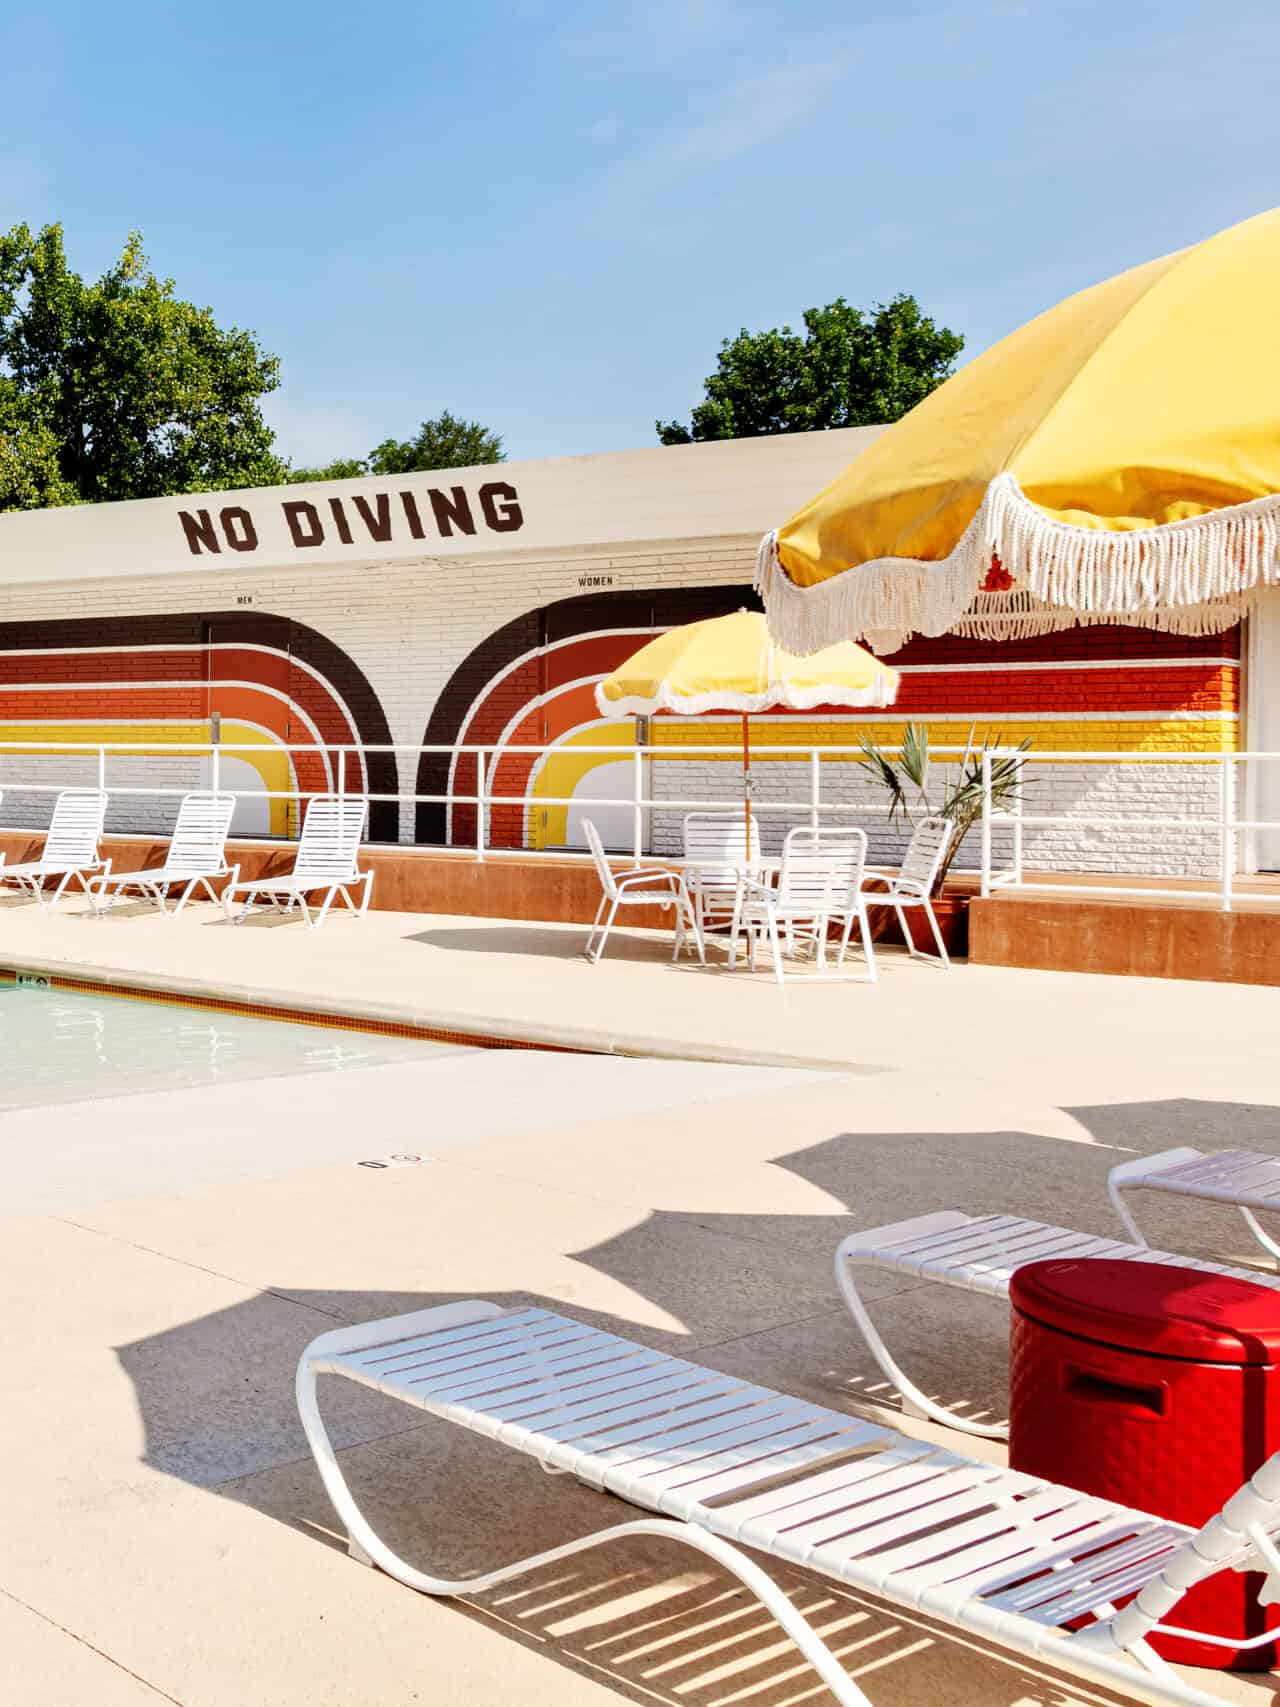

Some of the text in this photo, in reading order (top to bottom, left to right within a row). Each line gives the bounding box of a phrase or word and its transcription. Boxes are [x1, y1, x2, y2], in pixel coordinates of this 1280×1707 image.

[177, 481, 524, 555] NO DIVING
[577, 576, 613, 587] WOMEN
